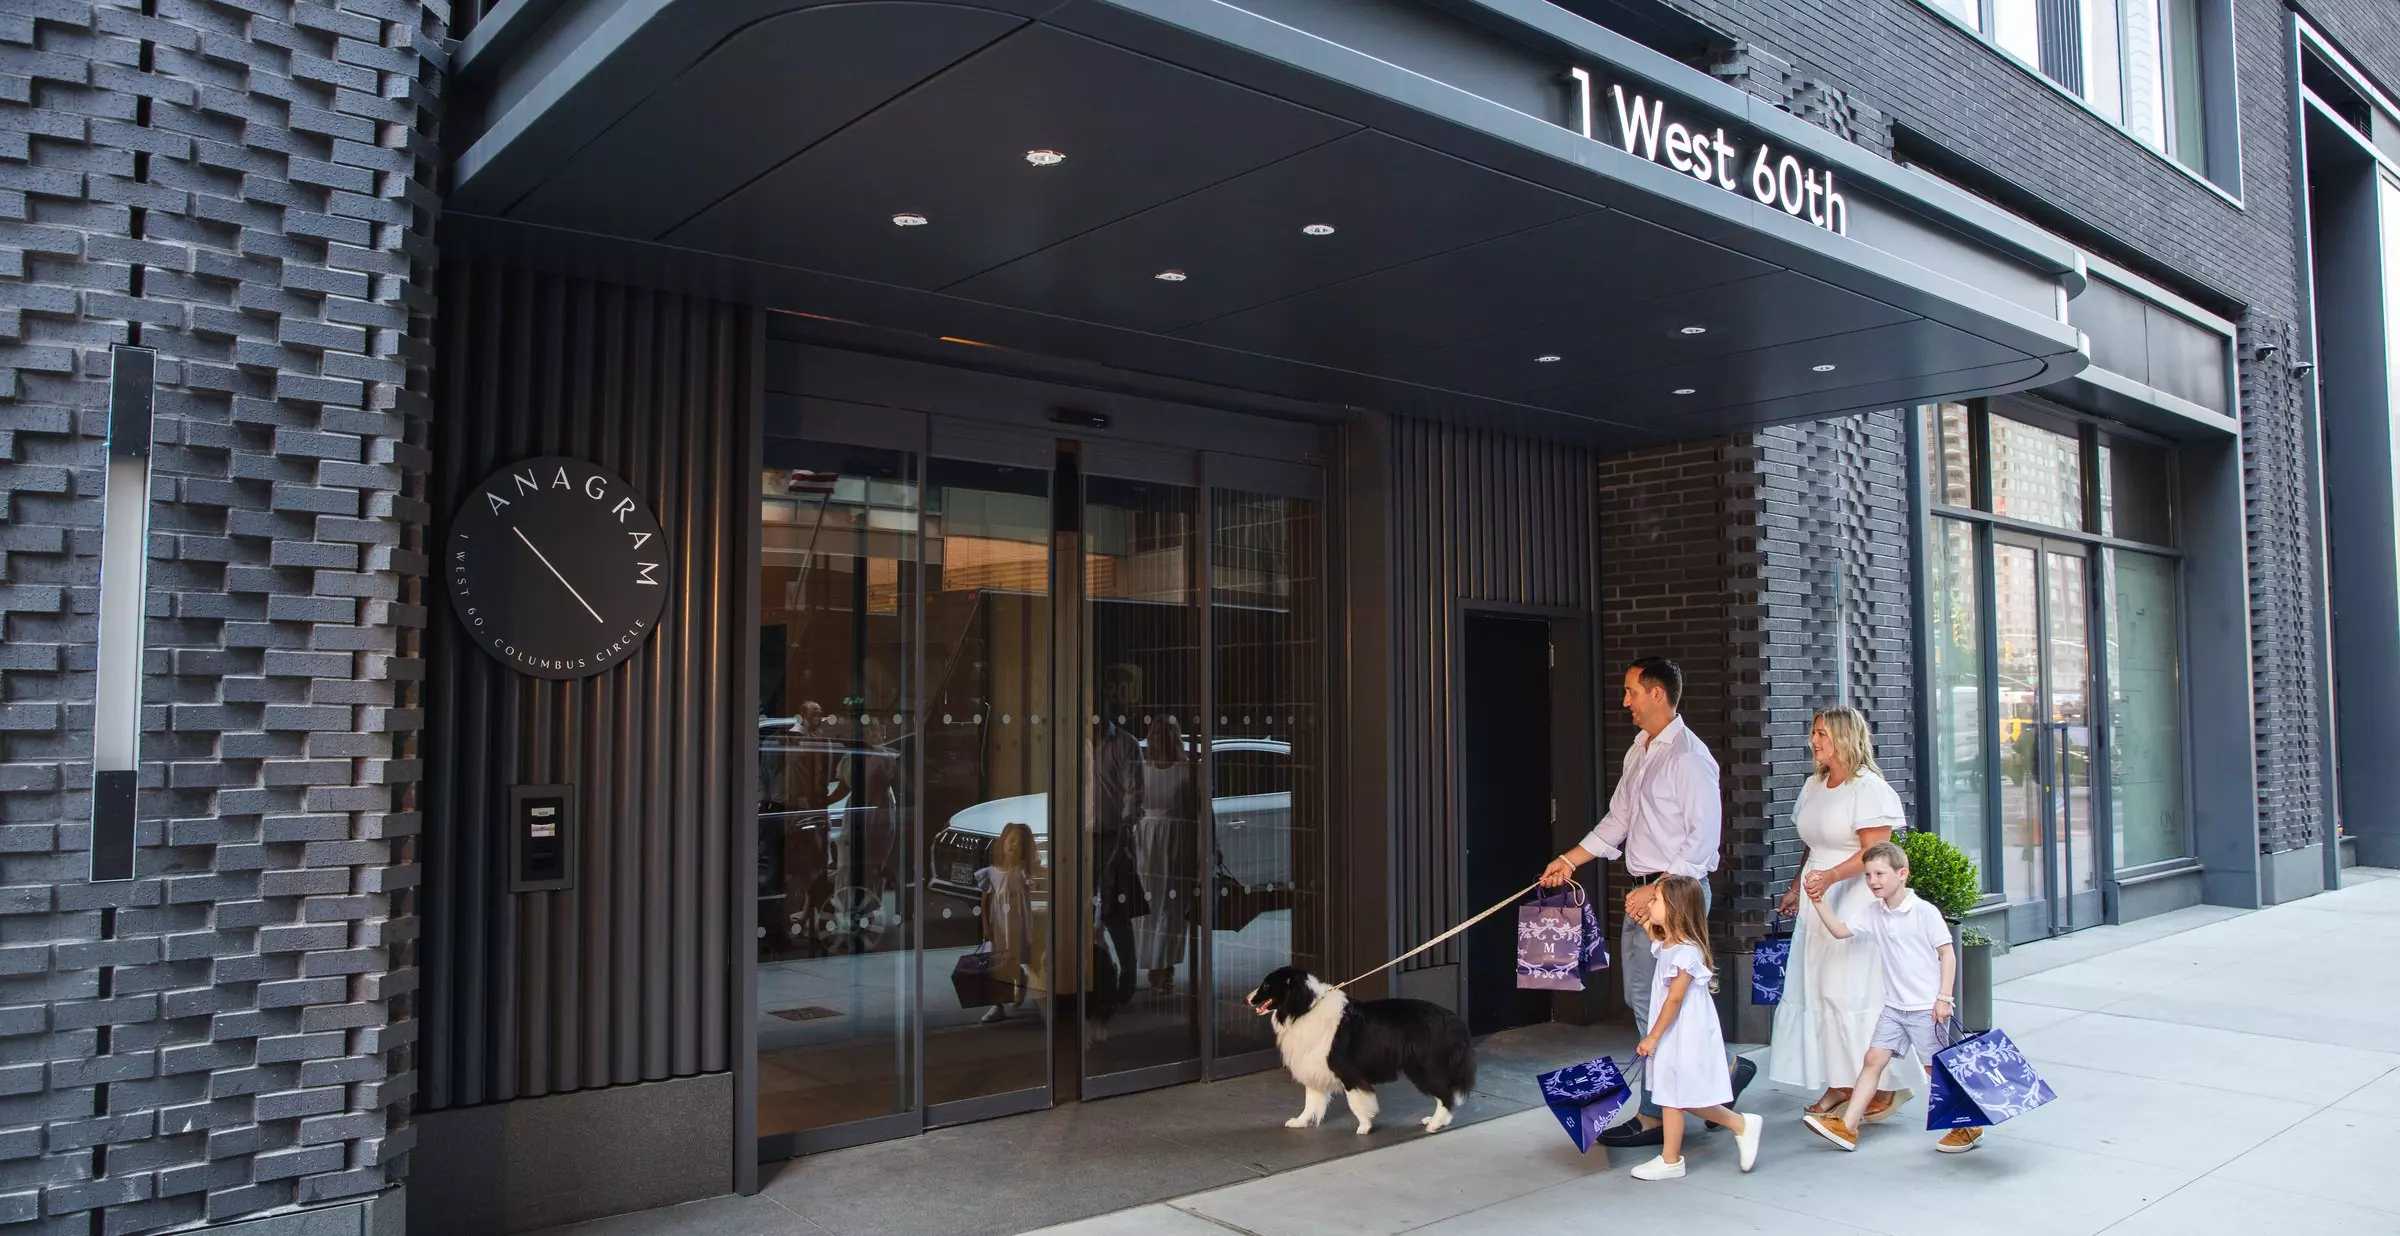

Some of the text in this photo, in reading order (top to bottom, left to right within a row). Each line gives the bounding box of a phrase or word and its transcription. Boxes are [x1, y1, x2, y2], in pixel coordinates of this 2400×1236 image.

[1572, 66, 1847, 237] 1 West 60th
[486, 466, 659, 586] ANAGRAM
[455, 551, 470, 596] WEST
[494, 638, 586, 670] COLUMBUS
[596, 618, 645, 662] CIRCLE
[1543, 942, 1555, 953] M
[1985, 1067, 2008, 1087] M
